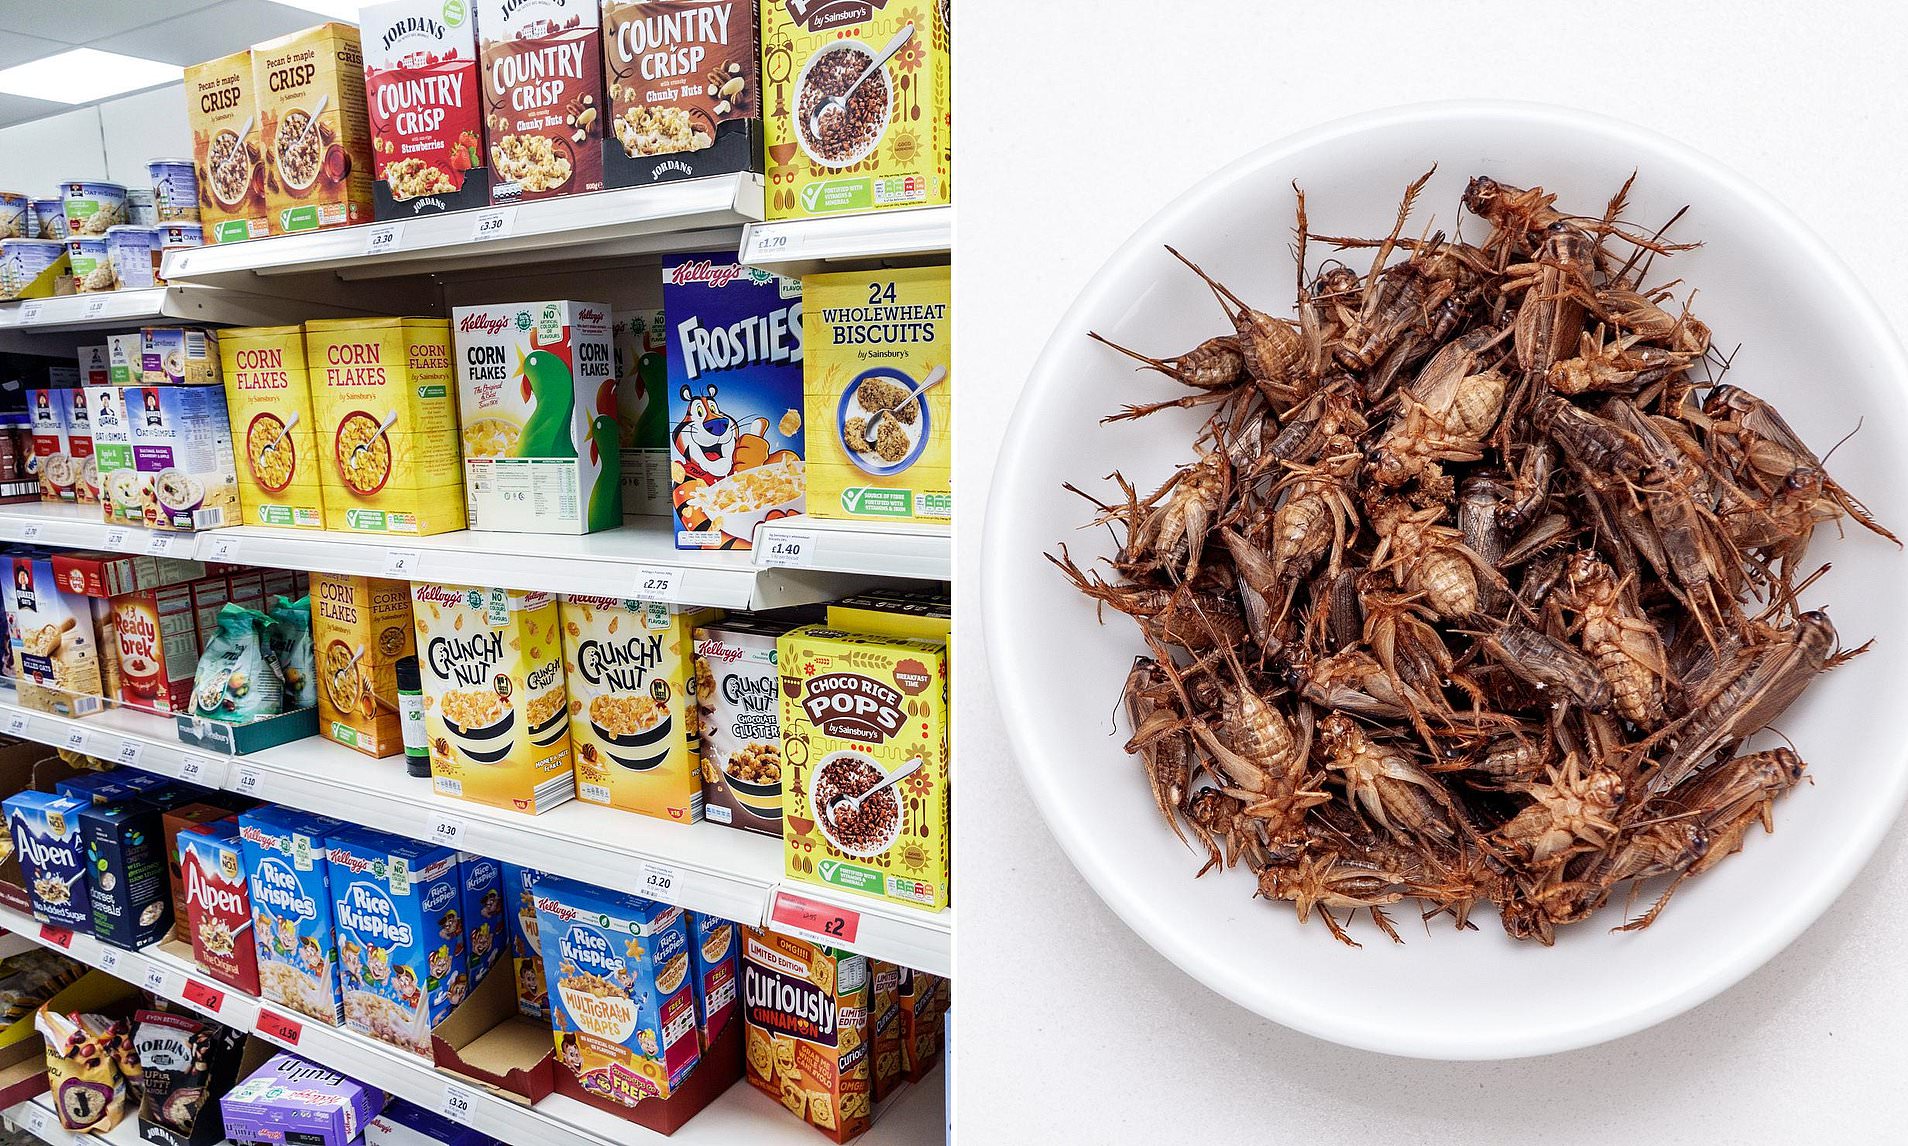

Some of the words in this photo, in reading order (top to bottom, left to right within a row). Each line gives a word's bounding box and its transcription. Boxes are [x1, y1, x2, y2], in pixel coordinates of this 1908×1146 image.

[814, 15, 824, 27] by
[824, 8, 867, 23] Sainsbury's
[382, 17, 445, 50] JORDANS
[617, 3, 733, 64] COUNTRY
[266, 58, 285, 69] Pecan
[286, 55, 291, 63] &
[292, 50, 315, 61] maple
[337, 52, 363, 65] CRIS
[492, 41, 586, 95] COUNTRY
[198, 80, 215, 91] Pecan
[221, 74, 240, 86] maple
[269, 63, 315, 93] CRISP
[201, 86, 241, 113] CRISP
[377, 73, 463, 119] COUNTRY
[646, 88, 678, 103] Chunky
[680, 84, 703, 98] Nuts
[516, 118, 543, 132] Chunky
[545, 114, 563, 128] Nuts
[401, 139, 445, 154] Strawberries
[650, 159, 693, 181] JORDANS
[413, 197, 446, 213] JORDANS
[480, 219, 503, 231] £3.30
[372, 234, 393, 245] £3.30
[759, 236, 787, 248] £1.70
[672, 260, 741, 287] Kellogg's
[868, 282, 896, 304] 24
[543, 311, 555, 319] NO
[578, 309, 604, 323] Kellogg's
[822, 304, 945, 323] WHOLEWHEAT
[460, 313, 509, 335] Kellogg's
[833, 323, 935, 345] BISCUITS
[236, 349, 282, 370] CORN
[327, 344, 380, 365] CORN
[410, 345, 445, 357] CORN
[467, 346, 506, 365] CORN
[579, 343, 609, 361] CORN
[857, 350, 867, 360] by
[868, 349, 909, 359] Sainsbury's
[409, 358, 449, 369] FLAKES
[469, 366, 506, 380] FLAKES
[581, 363, 609, 377] FLAKES
[236, 371, 288, 390] FLAKES
[327, 367, 386, 386] FLAKES
[346, 392, 377, 400] Sainsbury's
[772, 543, 800, 554] £1.40
[396, 560, 404, 568] £2
[320, 582, 354, 605] CORN
[644, 579, 668, 590] £2.75
[373, 593, 406, 605] CORN
[417, 585, 462, 607] Kellogg's
[492, 593, 502, 601] NO
[320, 601, 357, 625] FLAKES
[373, 601, 409, 614] FLAKES
[115, 611, 155, 643] Ready
[119, 633, 157, 662] brek
[428, 631, 504, 679] CRUNCHY
[699, 640, 744, 661] Kellogg's
[578, 635, 663, 685] CRUNCHY
[454, 663, 493, 687] NUT
[527, 657, 560, 690] CRUNCHY
[540, 673, 555, 689] NUT
[606, 666, 647, 693] NUT
[896, 673, 929, 683] BREAKFAST
[723, 674, 778, 704] CRUNCH
[811, 678, 859, 694] CHOCO
[861, 681, 898, 705] RICE
[744, 697, 771, 712] NUT
[807, 695, 900, 729] POPS
[738, 715, 777, 725] CHOCOLATE
[829, 723, 838, 735] by
[838, 725, 878, 740] Sainsbury's
[184, 763, 198, 773] £2.20
[241, 777, 255, 787] £1.10
[243, 826, 276, 850] Kellogg's
[436, 824, 456, 836] £3.30
[17, 824, 76, 870] Alpen
[331, 849, 369, 873] Kellogg's
[394, 865, 404, 874] NO
[263, 862, 296, 890] Rice
[468, 870, 497, 888] Krispies
[475, 865, 489, 877] Rice
[187, 861, 243, 916] Alpen
[647, 875, 671, 888] £3.20
[90, 887, 115, 904] dorset
[254, 879, 314, 918] Krispies
[353, 886, 390, 916] Rice
[424, 890, 455, 909] Krispies
[431, 885, 447, 898] Rice
[44, 904, 65, 917] Added
[65, 908, 86, 922] Sugar
[91, 900, 121, 917] cereals
[538, 897, 577, 920] Kellogg's
[340, 904, 410, 944] Krispies
[825, 918, 846, 937] £2
[573, 927, 607, 950] Rice
[661, 932, 677, 948] Rice
[561, 939, 624, 971] Krispies
[654, 937, 684, 963] Krispies
[751, 943, 777, 964] LIMITED
[778, 959, 804, 973] EDITION
[781, 940, 808, 960] OMG!!!!
[203, 952, 214, 966] The
[214, 956, 239, 975] Original
[712, 967, 727, 981] FREE!
[877, 972, 898, 984] LIMITED
[876, 980, 897, 992] EDITION
[206, 996, 217, 1008] £2
[566, 992, 631, 1023] MULTIGRAIN
[668, 996, 684, 1013] FREE!
[839, 1017, 866, 1026] EDITION
[841, 1009, 866, 1018] LIMITED
[279, 1025, 297, 1040] £1.50
[580, 1013, 621, 1036] SHAPES
[136, 1040, 190, 1062] JORDANS
[802, 1045, 820, 1061] GRAB
[821, 1058, 831, 1069] ME
[799, 1050, 818, 1068] WHILE
[819, 1065, 832, 1079] YOU
[812, 1070, 832, 1088] #YOLO
[614, 1077, 648, 1101] FREE
[449, 1097, 468, 1110] £3.20
